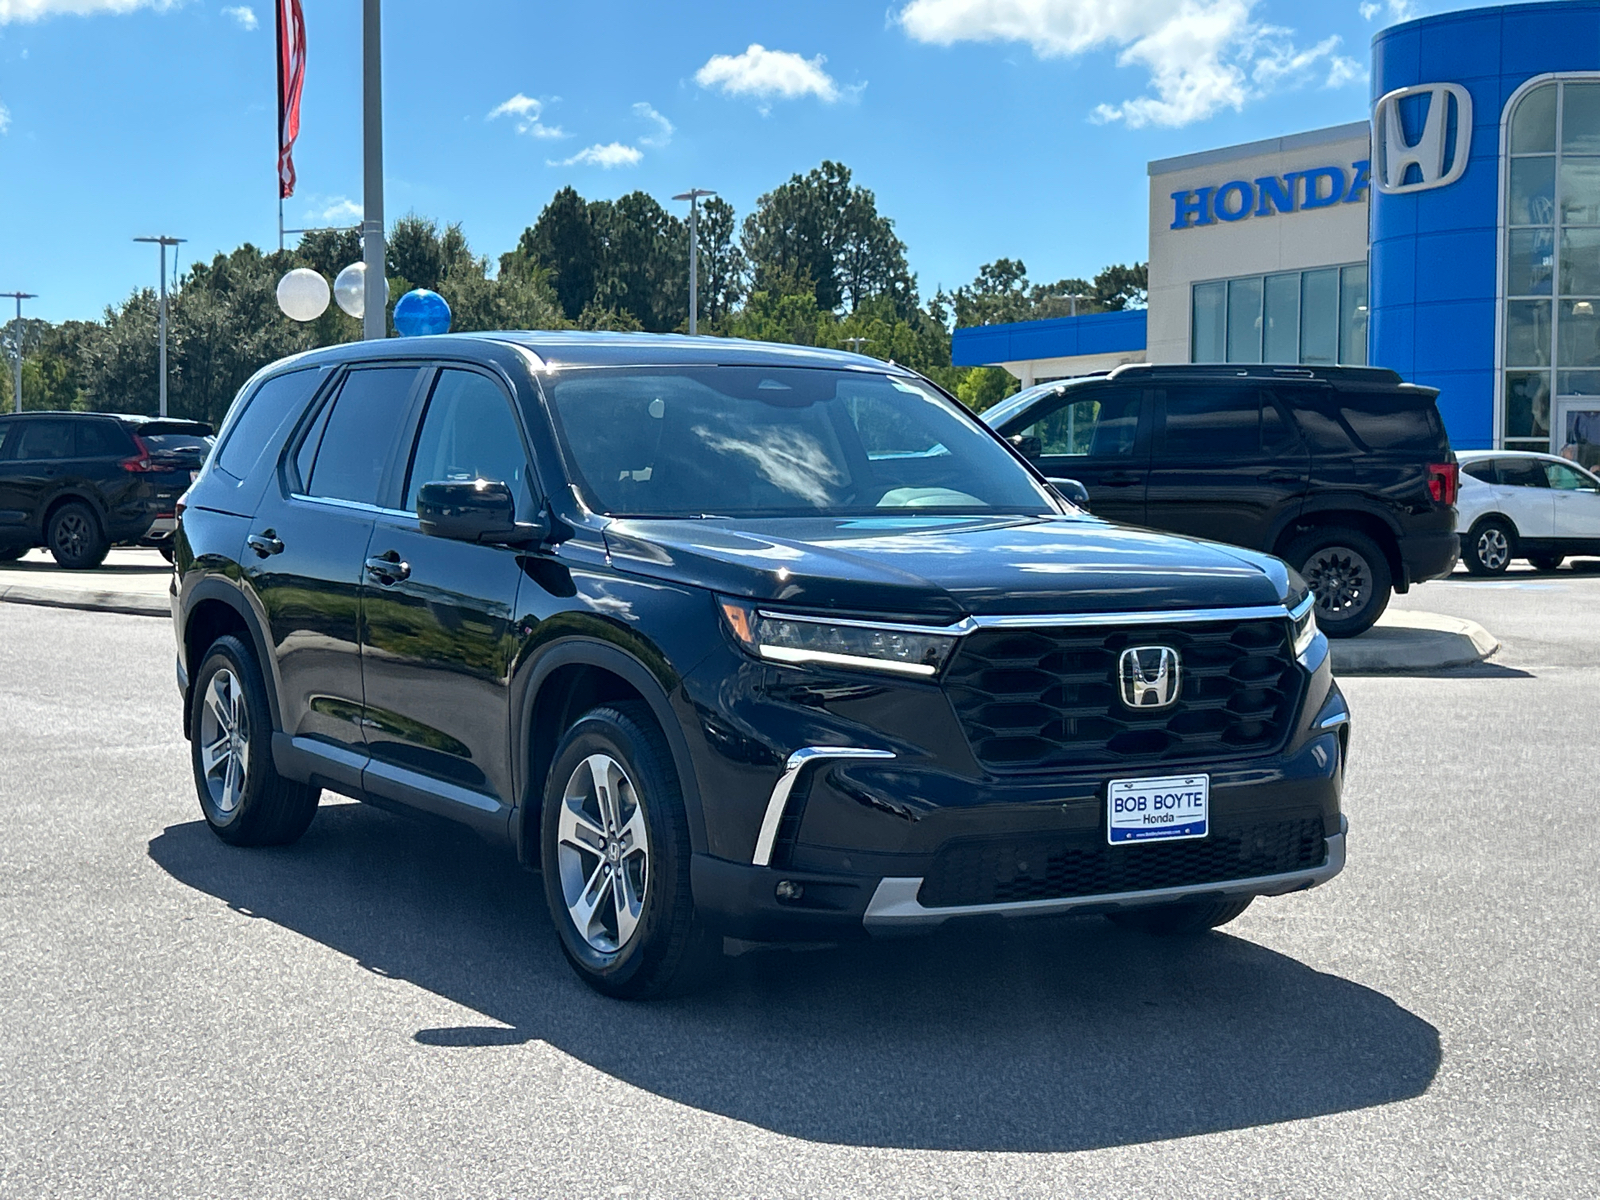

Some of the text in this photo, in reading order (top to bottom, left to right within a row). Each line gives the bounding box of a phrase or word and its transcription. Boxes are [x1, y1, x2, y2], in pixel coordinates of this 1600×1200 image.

[1115, 792, 1203, 813] BOB BOYTE
[1142, 812, 1175, 824] Honda
